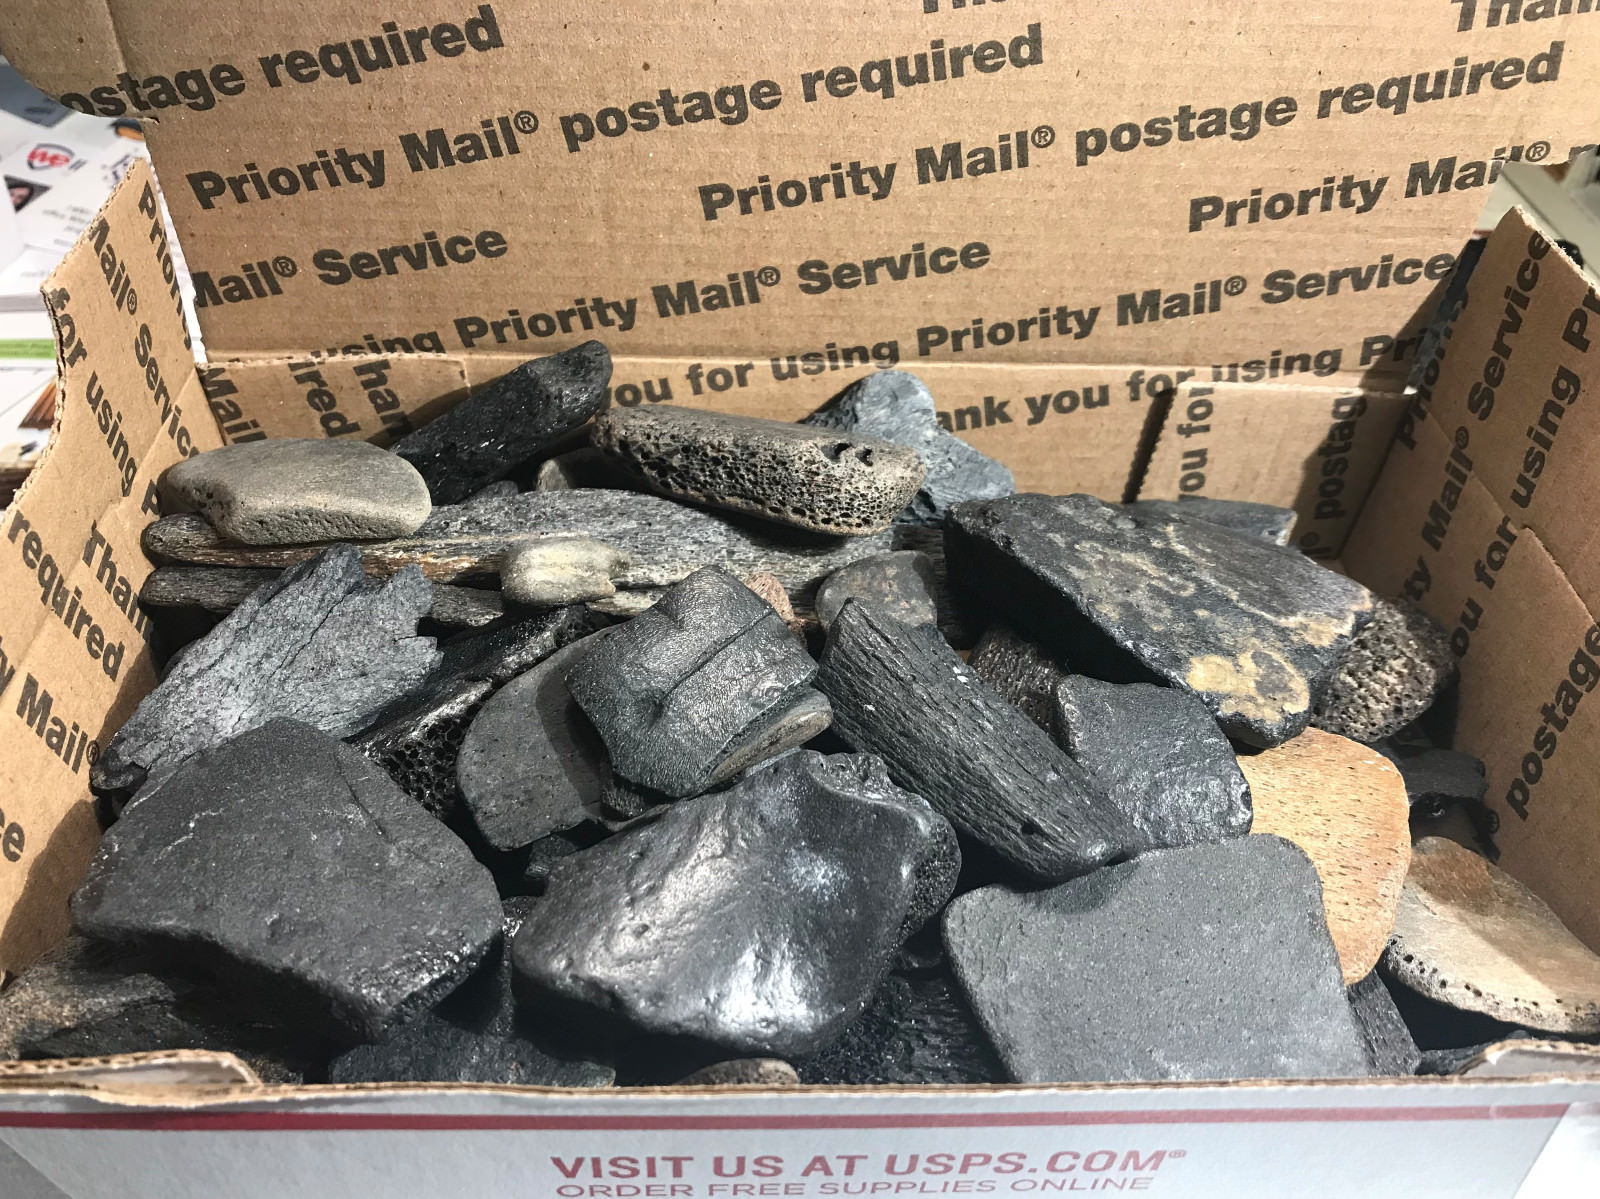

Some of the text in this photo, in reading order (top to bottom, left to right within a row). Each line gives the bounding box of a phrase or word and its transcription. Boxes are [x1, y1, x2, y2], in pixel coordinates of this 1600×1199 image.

[259, 4, 505, 89] required
[186, 147, 385, 210] Priority
[399, 110, 539, 172] Mail®
[559, 79, 782, 153] postage
[801, 22, 1043, 103] required
[698, 40, 1566, 221] Priority Mail® postage required
[1188, 173, 1390, 232] Priority
[312, 230, 508, 286] Service
[453, 297, 638, 348] Priority
[652, 265, 781, 318] Mail®
[797, 241, 991, 295] Service
[685, 361, 754, 396] for
[770, 339, 900, 382] using
[917, 305, 1101, 356] Priority
[1116, 275, 1248, 327] Mail®
[1260, 252, 1457, 305] Service
[1468, 231, 1551, 421] Service
[86, 370, 137, 497] using
[1024, 384, 1110, 426] you
[1211, 348, 1343, 384] using
[1178, 448, 1208, 501] ou
[1473, 514, 1518, 590] for
[1510, 365, 1581, 509] using
[7, 509, 125, 683] required
[550, 1155, 695, 1179] VISIT
[712, 1154, 785, 1178] US
[800, 1154, 869, 1178] AT
[556, 1177, 1155, 1198] ORDER FREE SUPPLIES ONLINE
